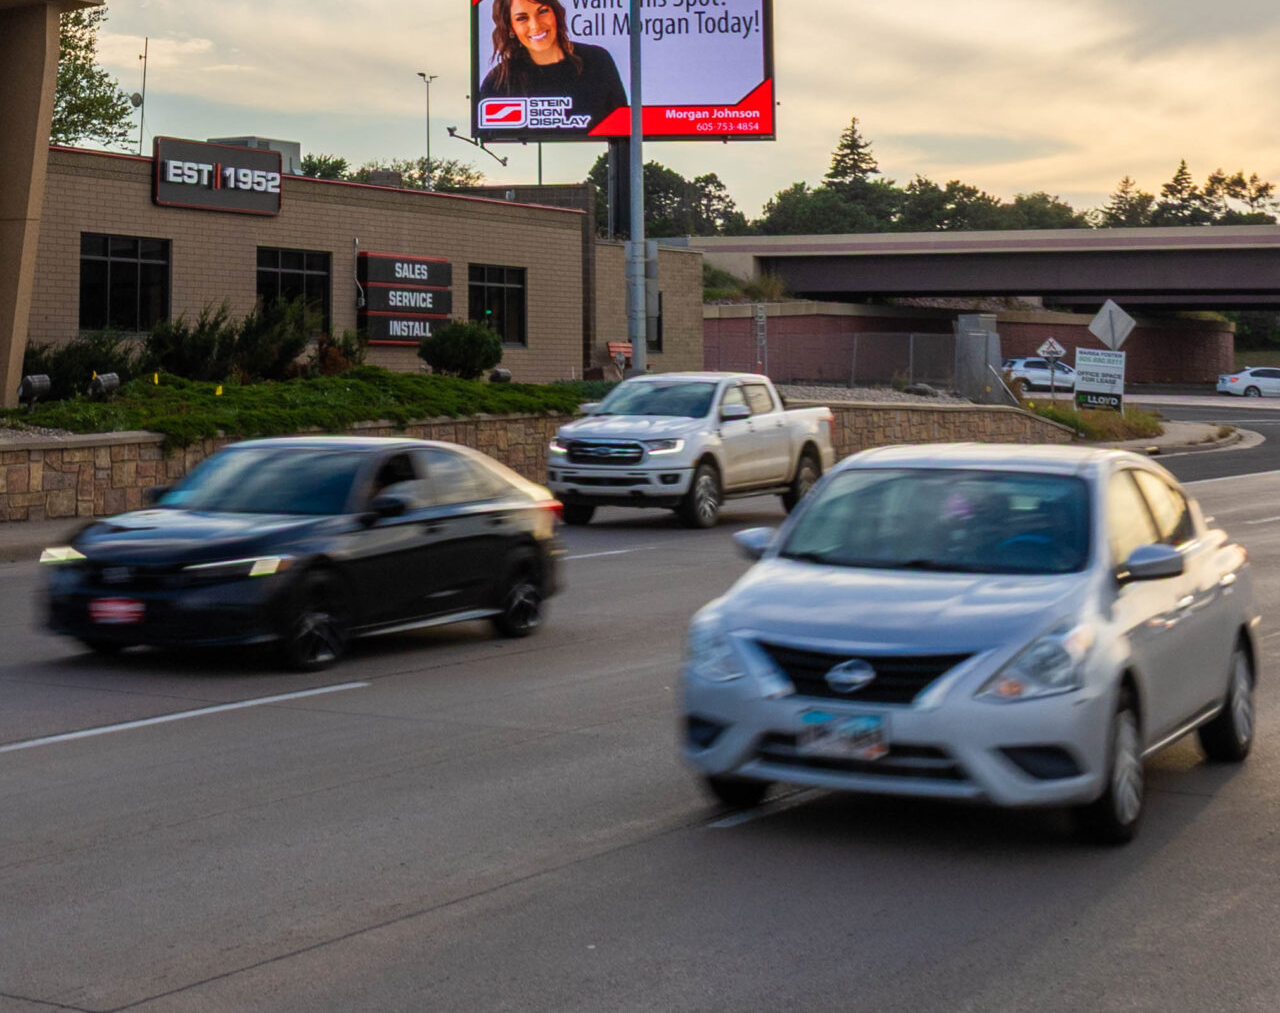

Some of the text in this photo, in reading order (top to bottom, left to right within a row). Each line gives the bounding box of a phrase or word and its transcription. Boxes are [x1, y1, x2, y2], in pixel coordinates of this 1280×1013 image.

[570, 9, 760, 41] Call Mrgan Today!
[529, 99, 570, 107] STEIN
[529, 108, 563, 117] SIGN
[665, 108, 760, 121] Morgan Johnson
[529, 117, 589, 126] DISPLAY
[166, 160, 281, 193] EST 1952
[395, 262, 428, 280] SALES
[388, 290, 433, 308] SERVICE
[389, 320, 432, 337] INSTALL
[1088, 395, 1118, 405] LLOYD
